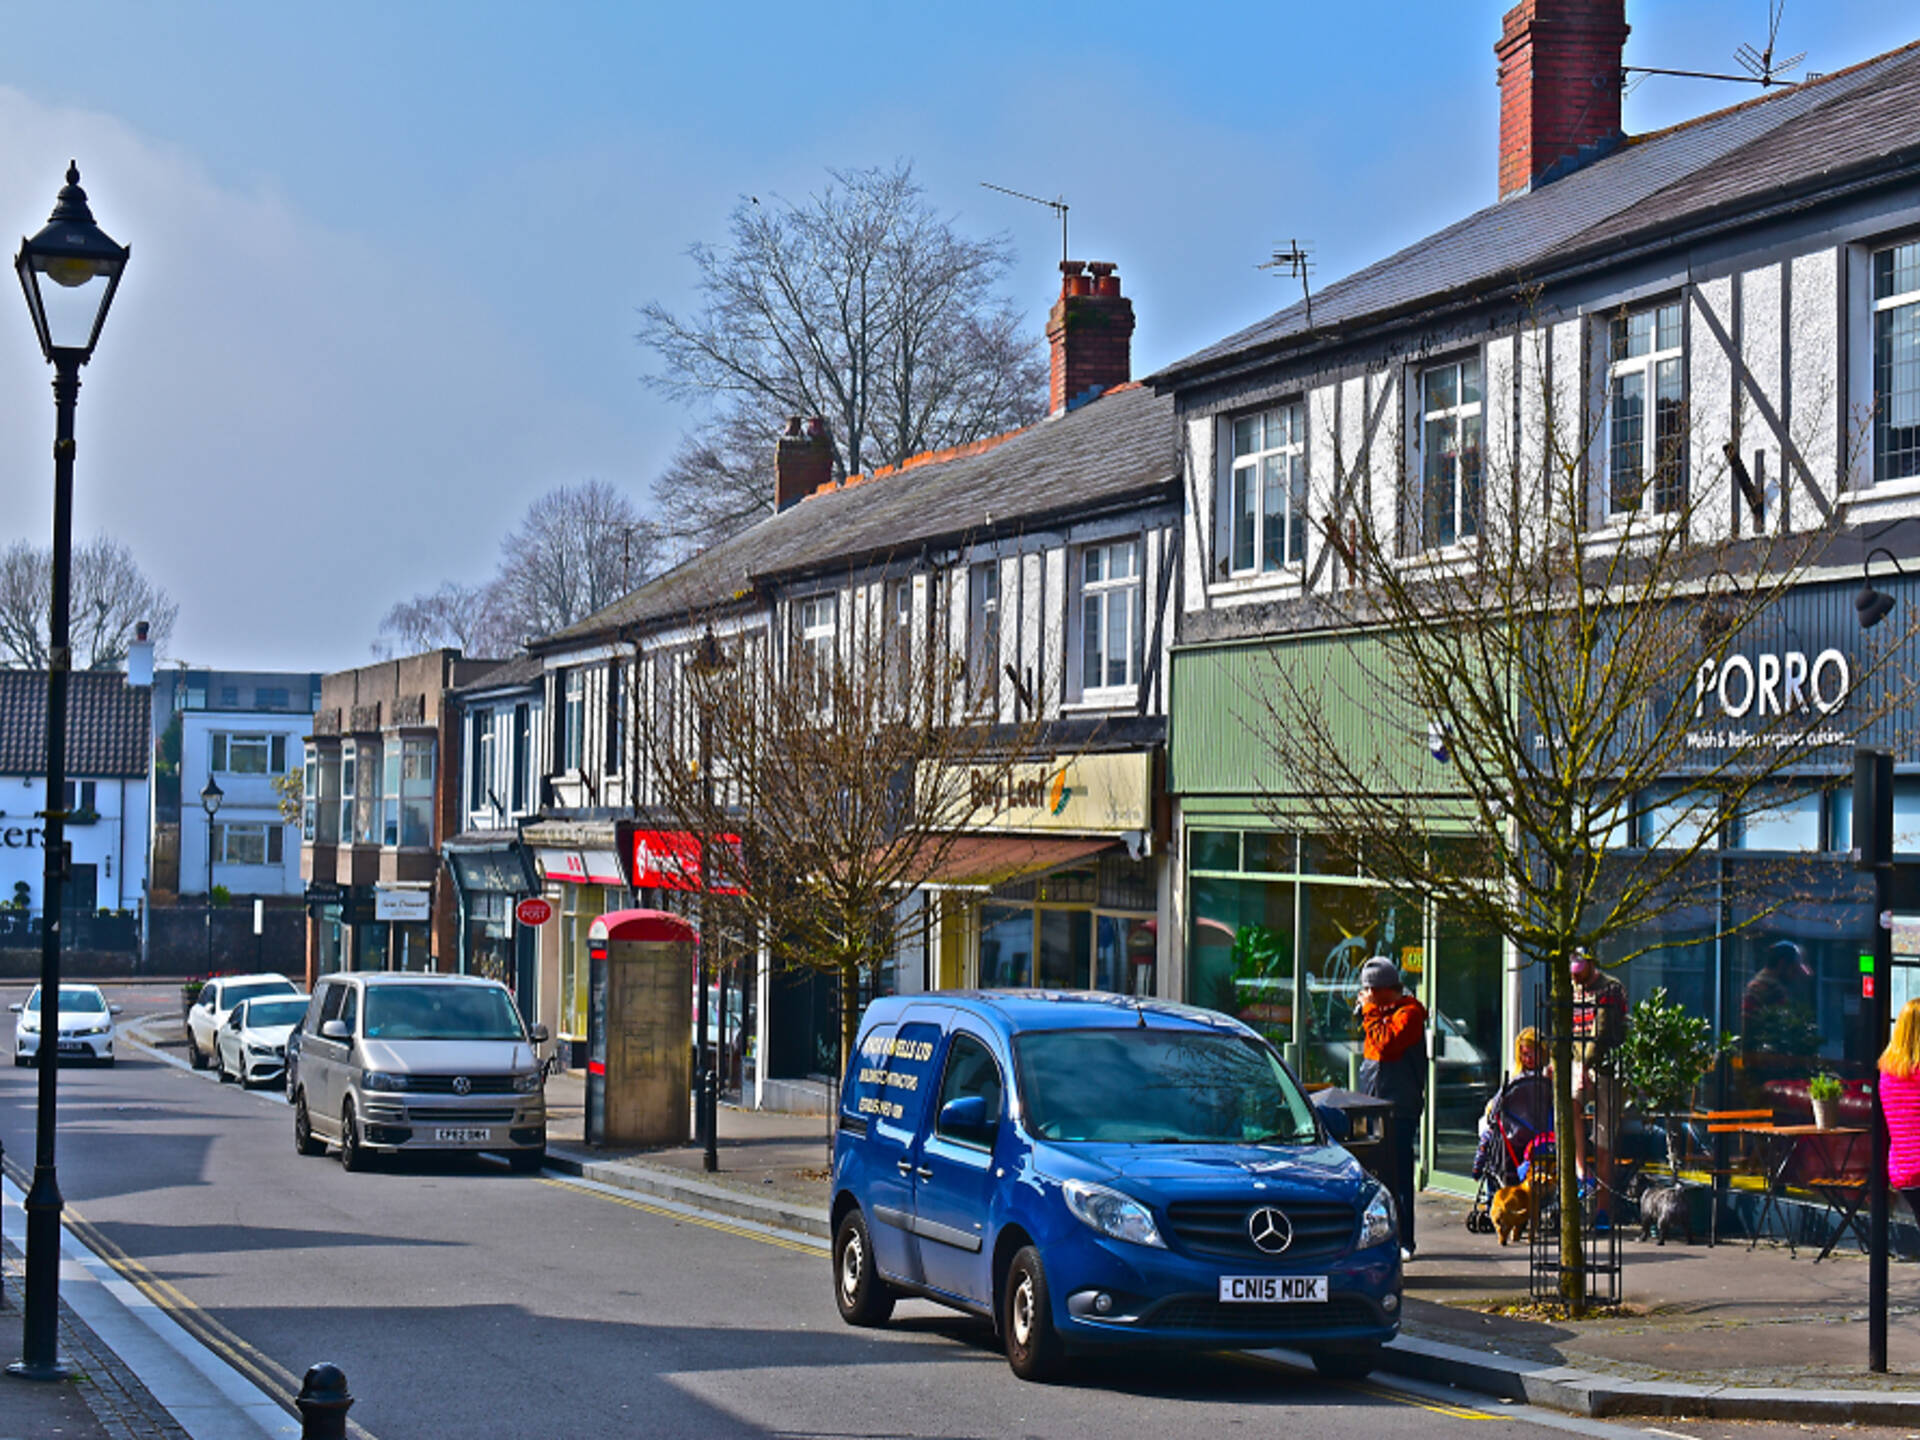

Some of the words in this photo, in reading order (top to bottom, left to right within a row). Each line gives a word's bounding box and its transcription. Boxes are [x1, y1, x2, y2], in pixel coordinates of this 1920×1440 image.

[1695, 648, 1849, 718] PORRO
[1008, 767, 1046, 807] Leaf
[522, 910, 545, 920] POST
[1232, 1279, 1276, 1299] CN15
